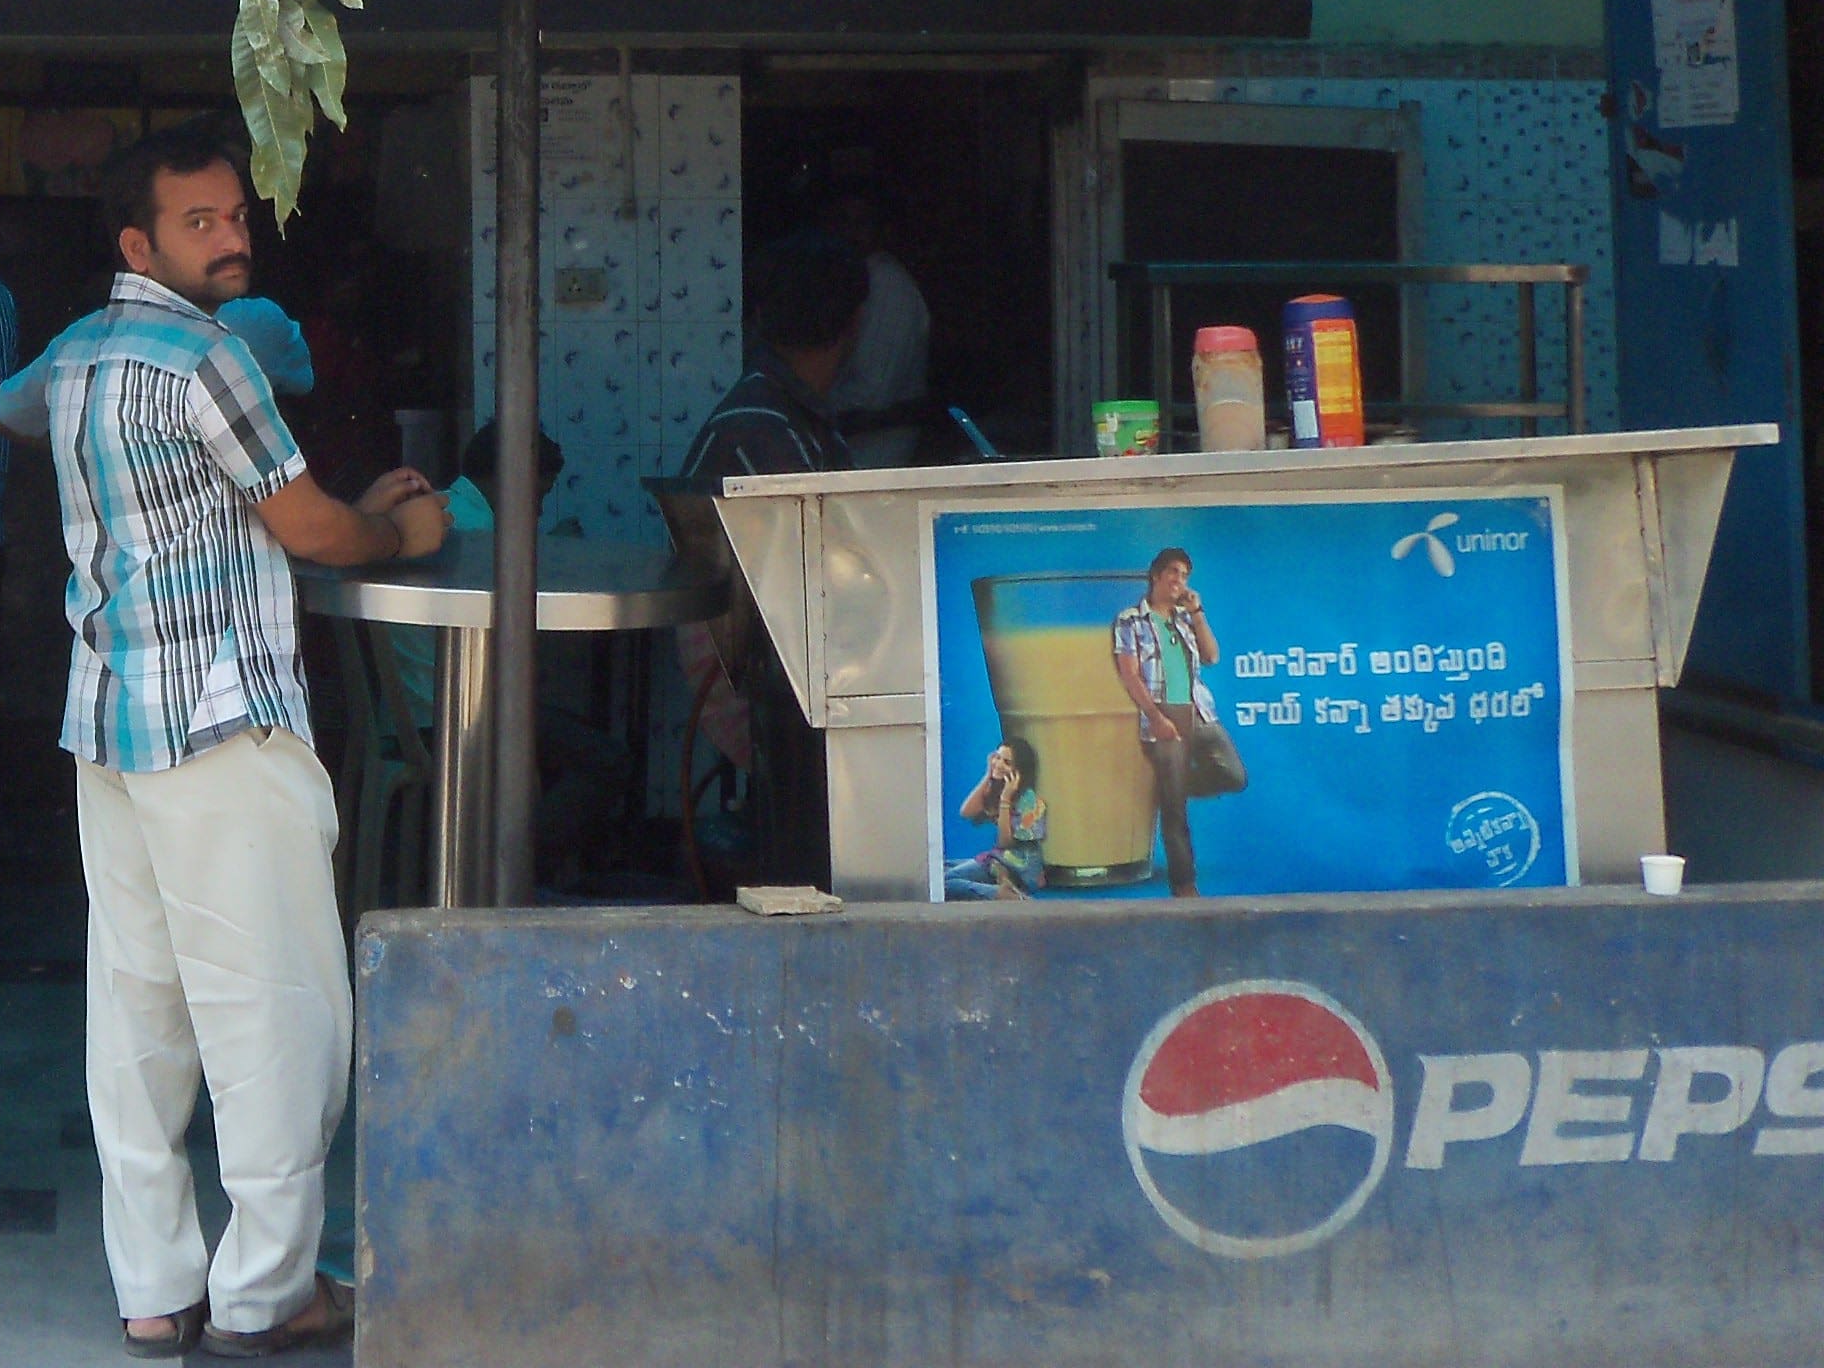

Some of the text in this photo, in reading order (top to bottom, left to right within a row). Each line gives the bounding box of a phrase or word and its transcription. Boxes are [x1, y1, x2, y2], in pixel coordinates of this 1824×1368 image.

[1456, 528, 1529, 553] uninor
[1314, 696, 1371, 734] కన్నా
[1380, 692, 1456, 733] తక్కువ
[1469, 682, 1545, 725] ధరలో
